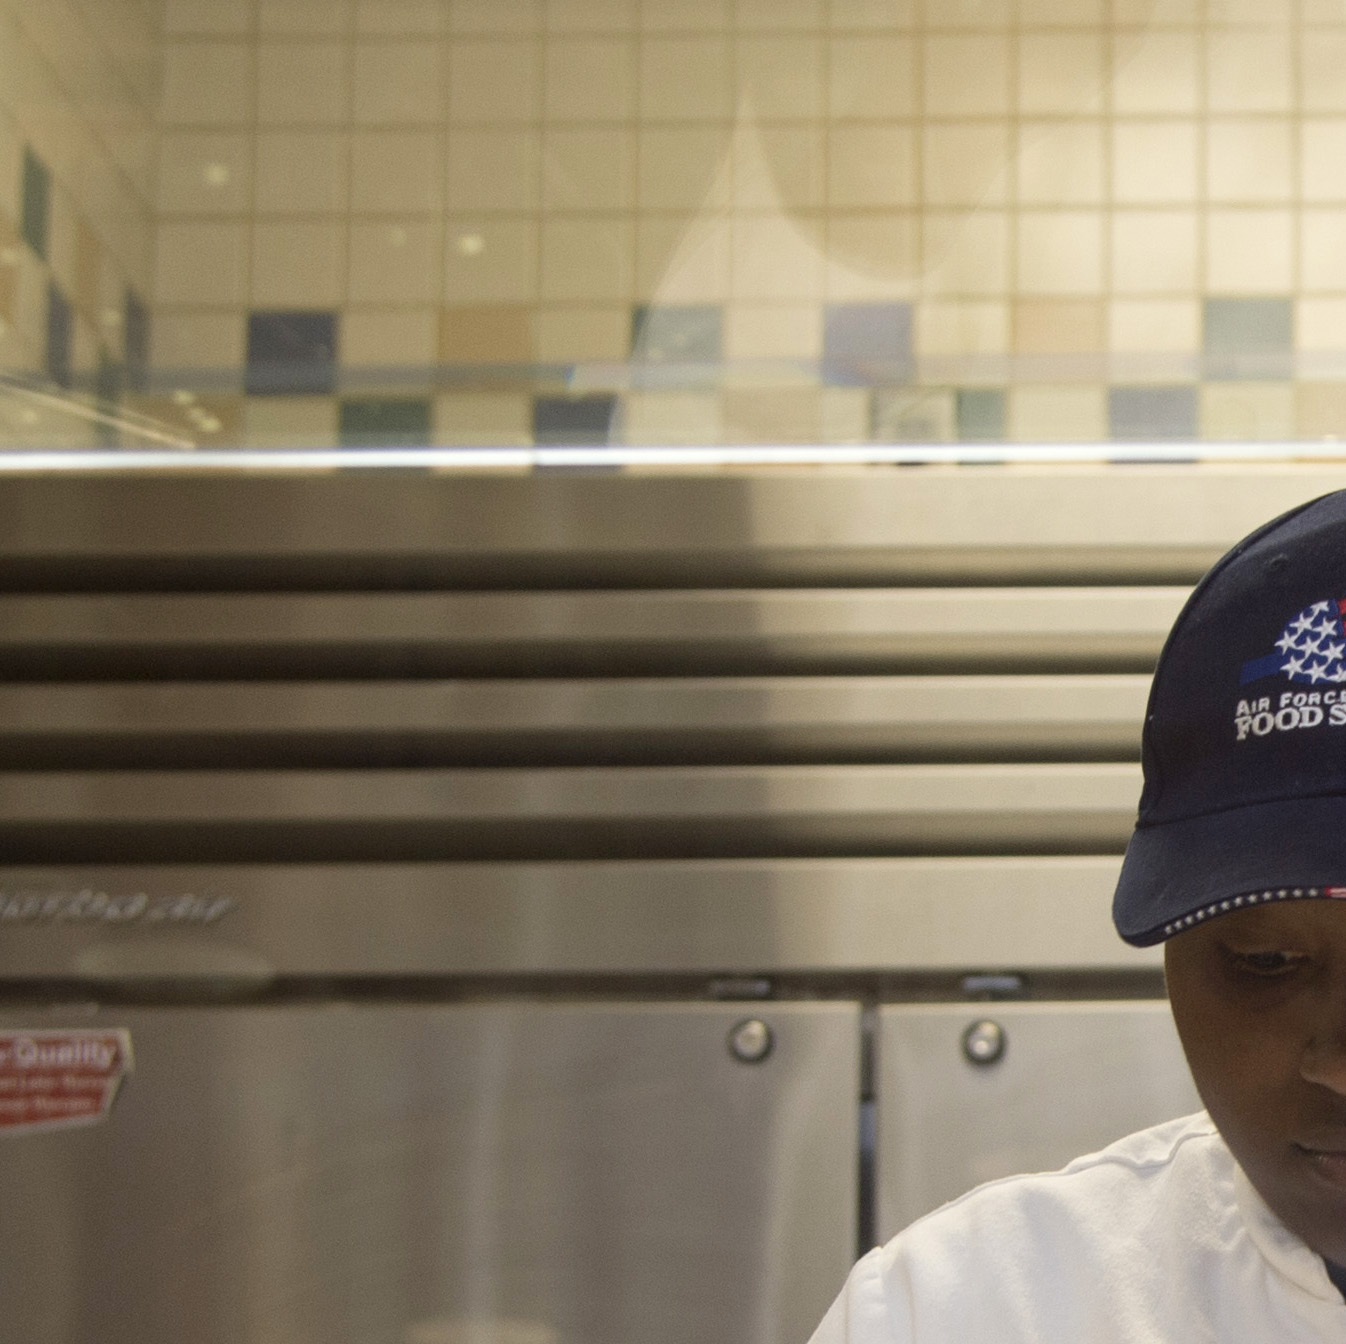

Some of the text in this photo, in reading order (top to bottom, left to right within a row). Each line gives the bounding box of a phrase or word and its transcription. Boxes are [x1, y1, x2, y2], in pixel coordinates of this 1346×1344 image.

[1235, 698, 1271, 717] AIR
[1235, 706, 1324, 741] FOOD
[15, 1037, 119, 1073] Quality
